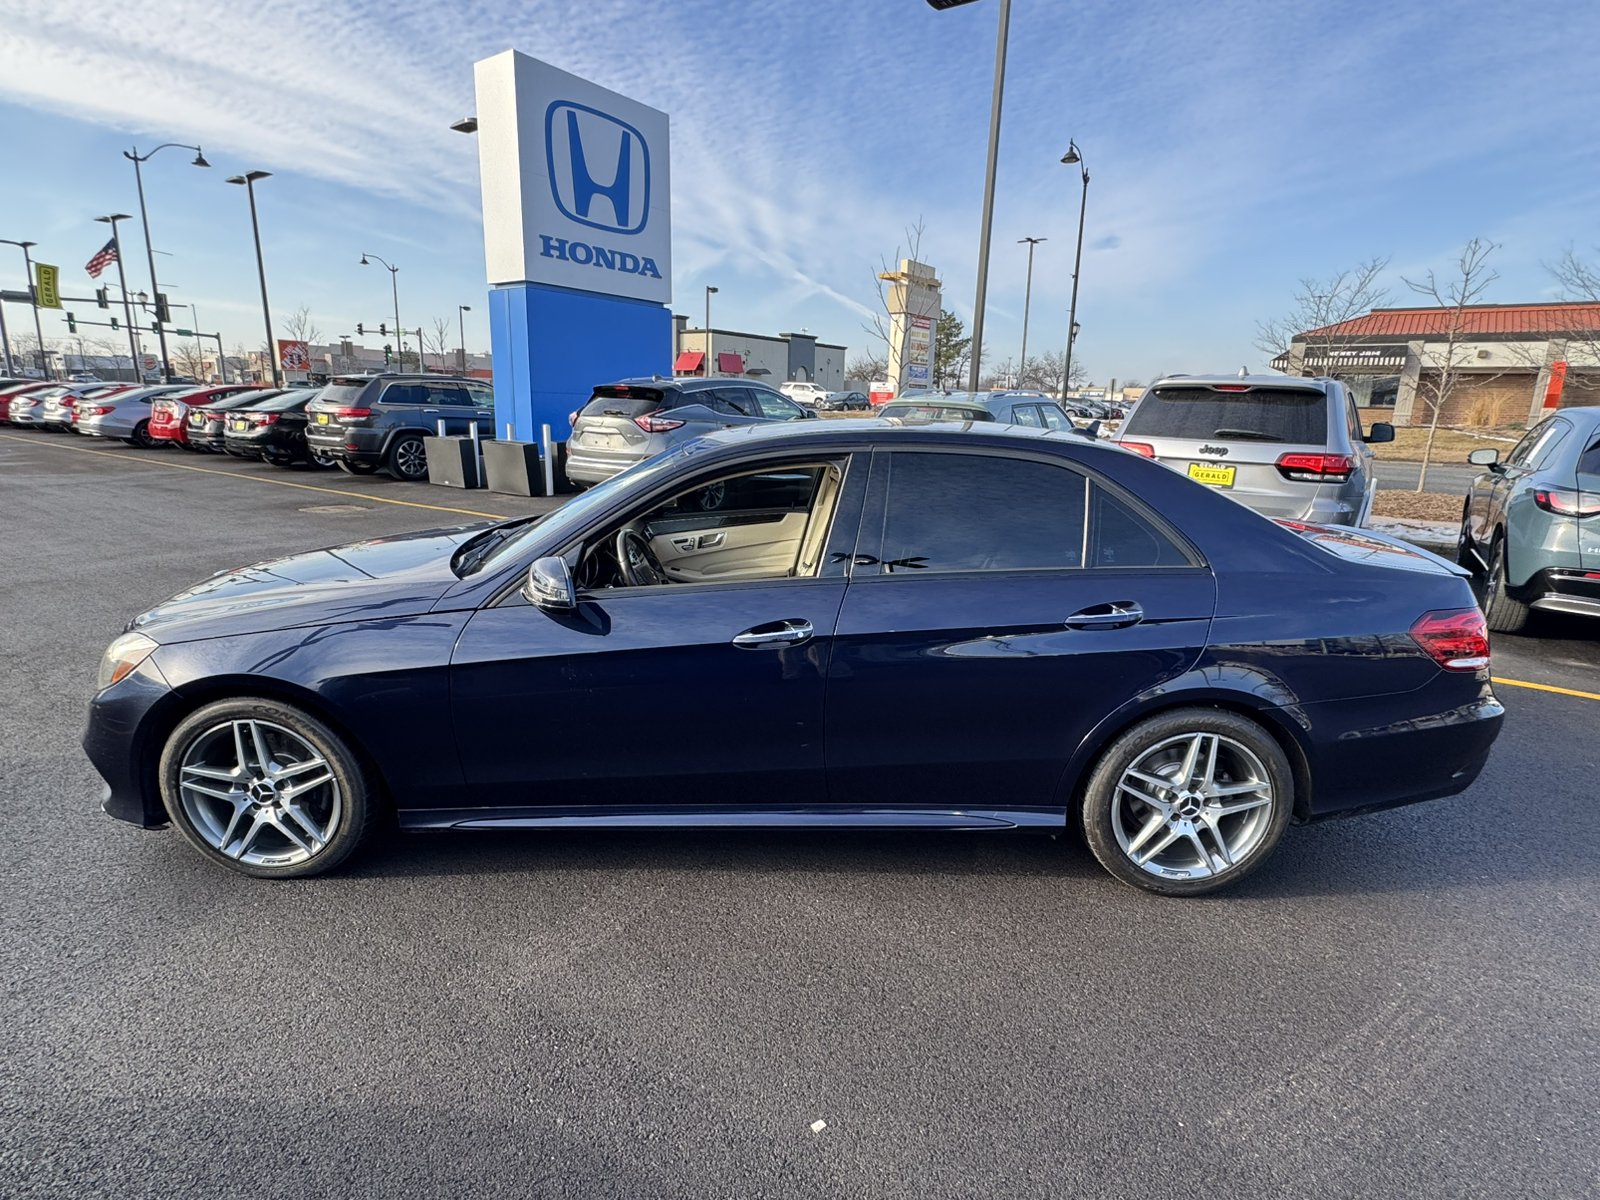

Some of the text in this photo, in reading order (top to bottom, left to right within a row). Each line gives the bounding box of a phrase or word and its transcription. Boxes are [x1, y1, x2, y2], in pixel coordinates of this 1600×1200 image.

[538, 234, 663, 279] HONDA
[43, 269, 54, 304] GERALD
[1198, 444, 1229, 457] Jeep
[1194, 471, 1227, 480] GERALD
